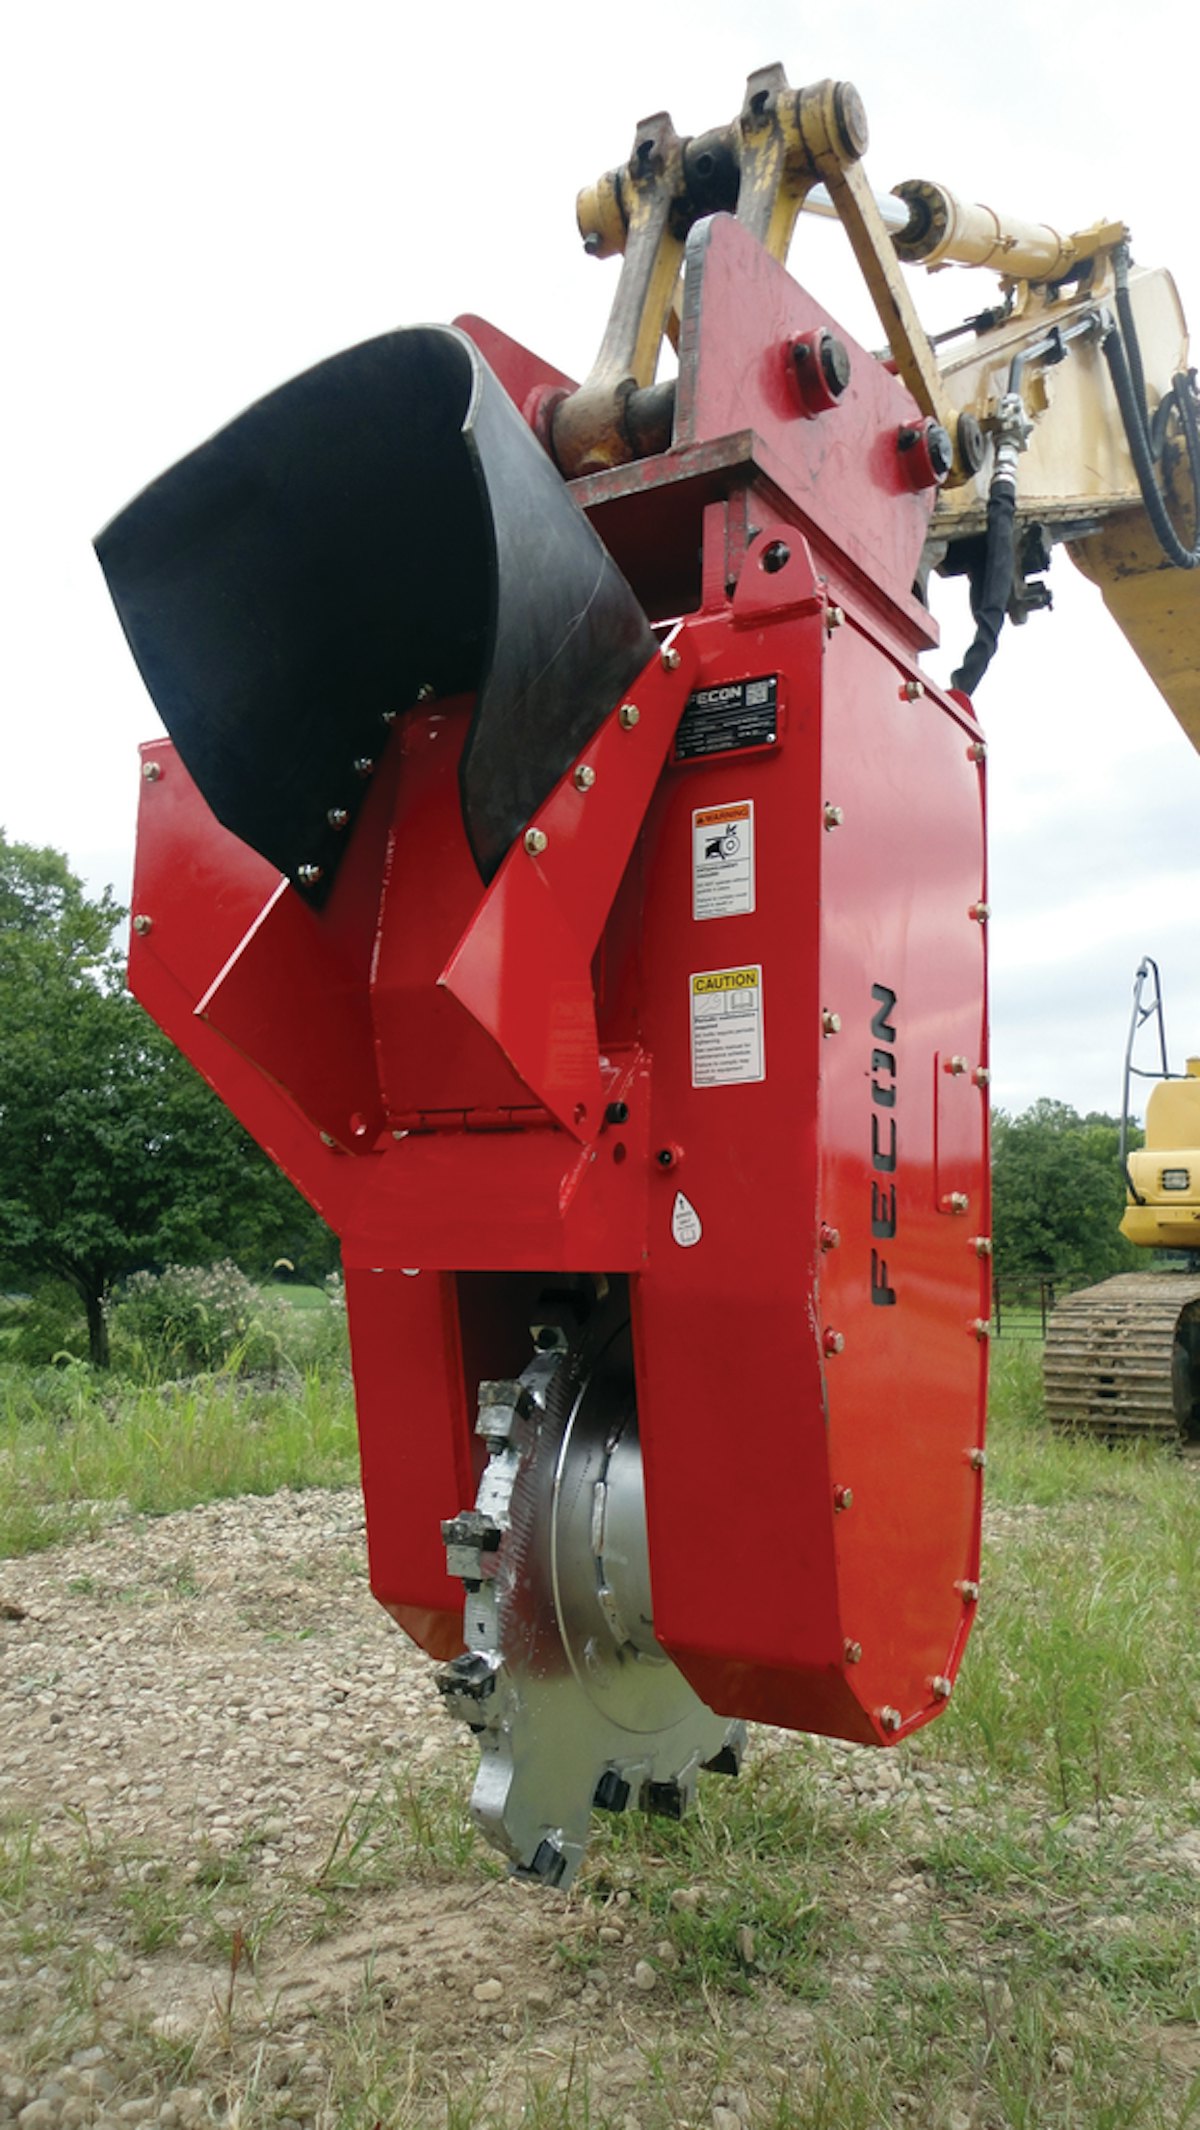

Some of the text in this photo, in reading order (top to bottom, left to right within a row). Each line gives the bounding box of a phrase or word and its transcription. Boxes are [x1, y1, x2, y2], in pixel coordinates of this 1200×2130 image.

[705, 808, 748, 821] WARNING
[696, 973, 755, 991] CAUTION
[871, 983, 896, 1306] FECON
